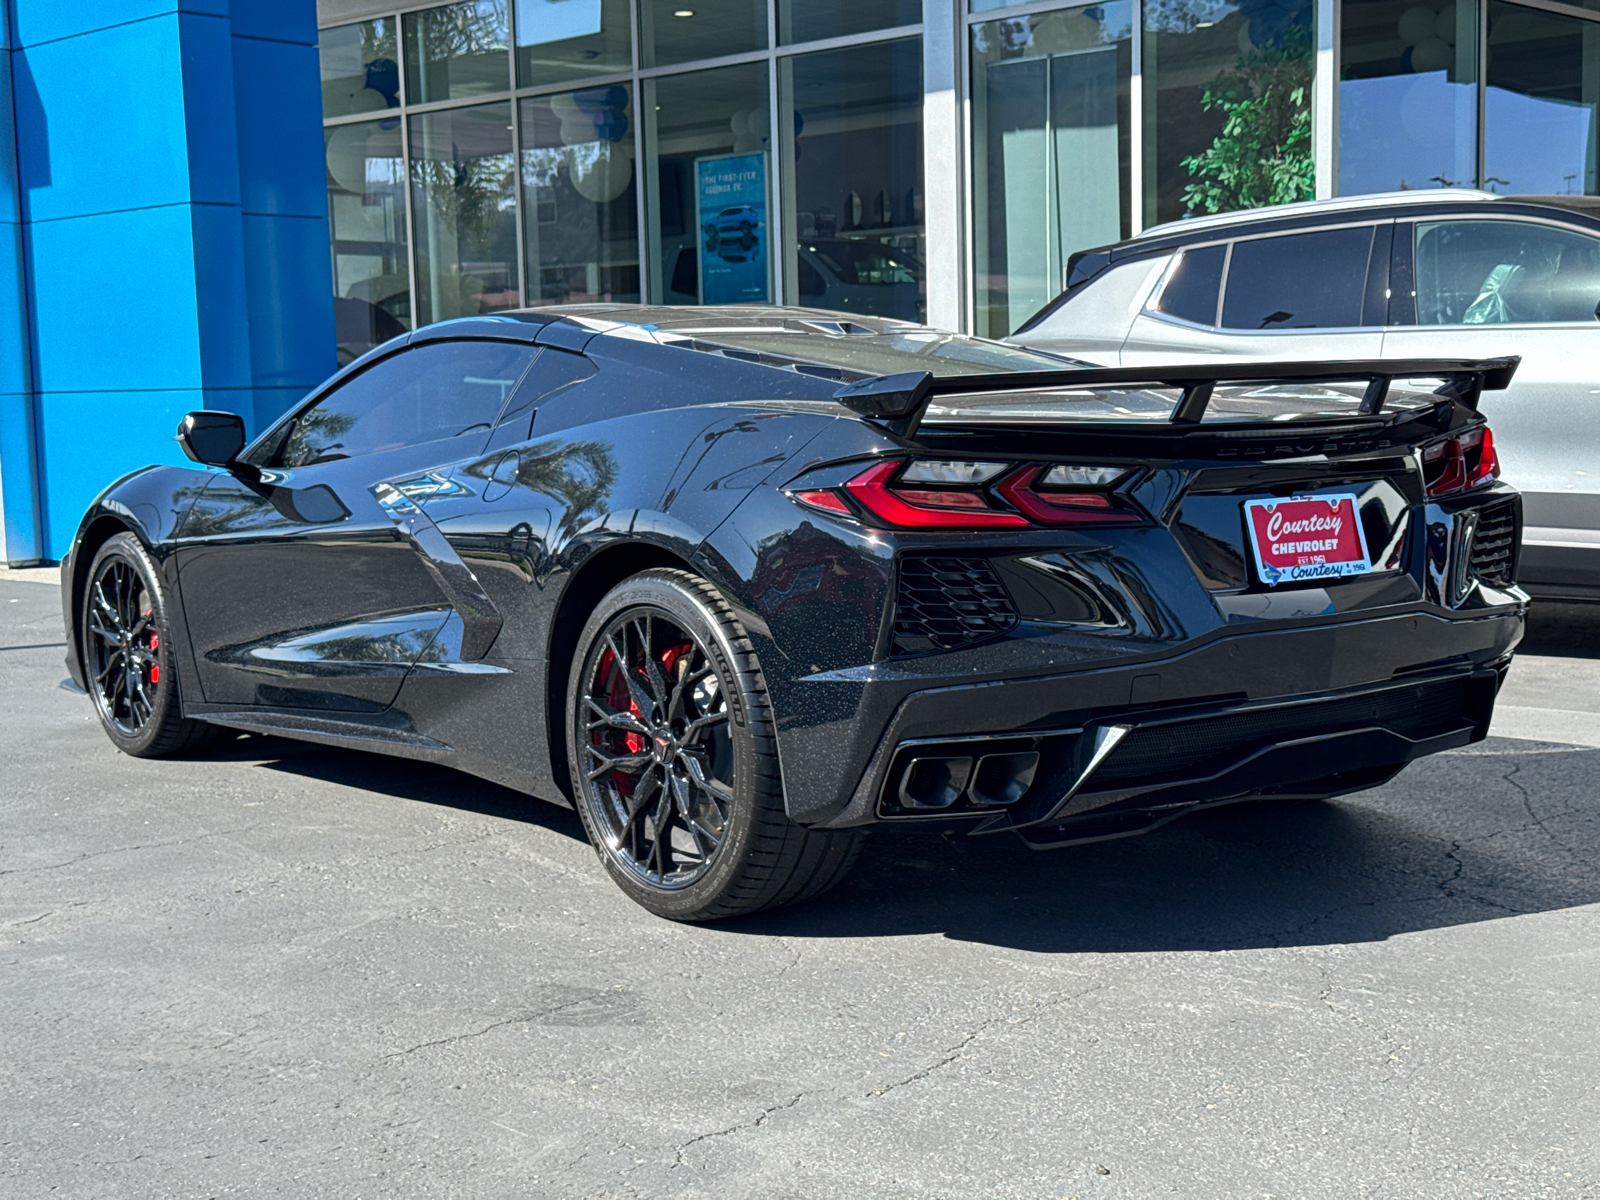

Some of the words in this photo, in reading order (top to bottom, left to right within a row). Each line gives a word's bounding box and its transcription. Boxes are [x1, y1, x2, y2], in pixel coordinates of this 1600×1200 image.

[705, 175, 717, 184] THE
[718, 171, 756, 183] FIRST-EVER
[1217, 439, 1391, 456] CORVETTE
[1267, 512, 1343, 542] Courtesy
[1271, 538, 1339, 555] CHEVROLET
[1310, 554, 1326, 565] 1961
[1291, 563, 1343, 579] Courtesy
[710, 642, 744, 722] MICHELIN
